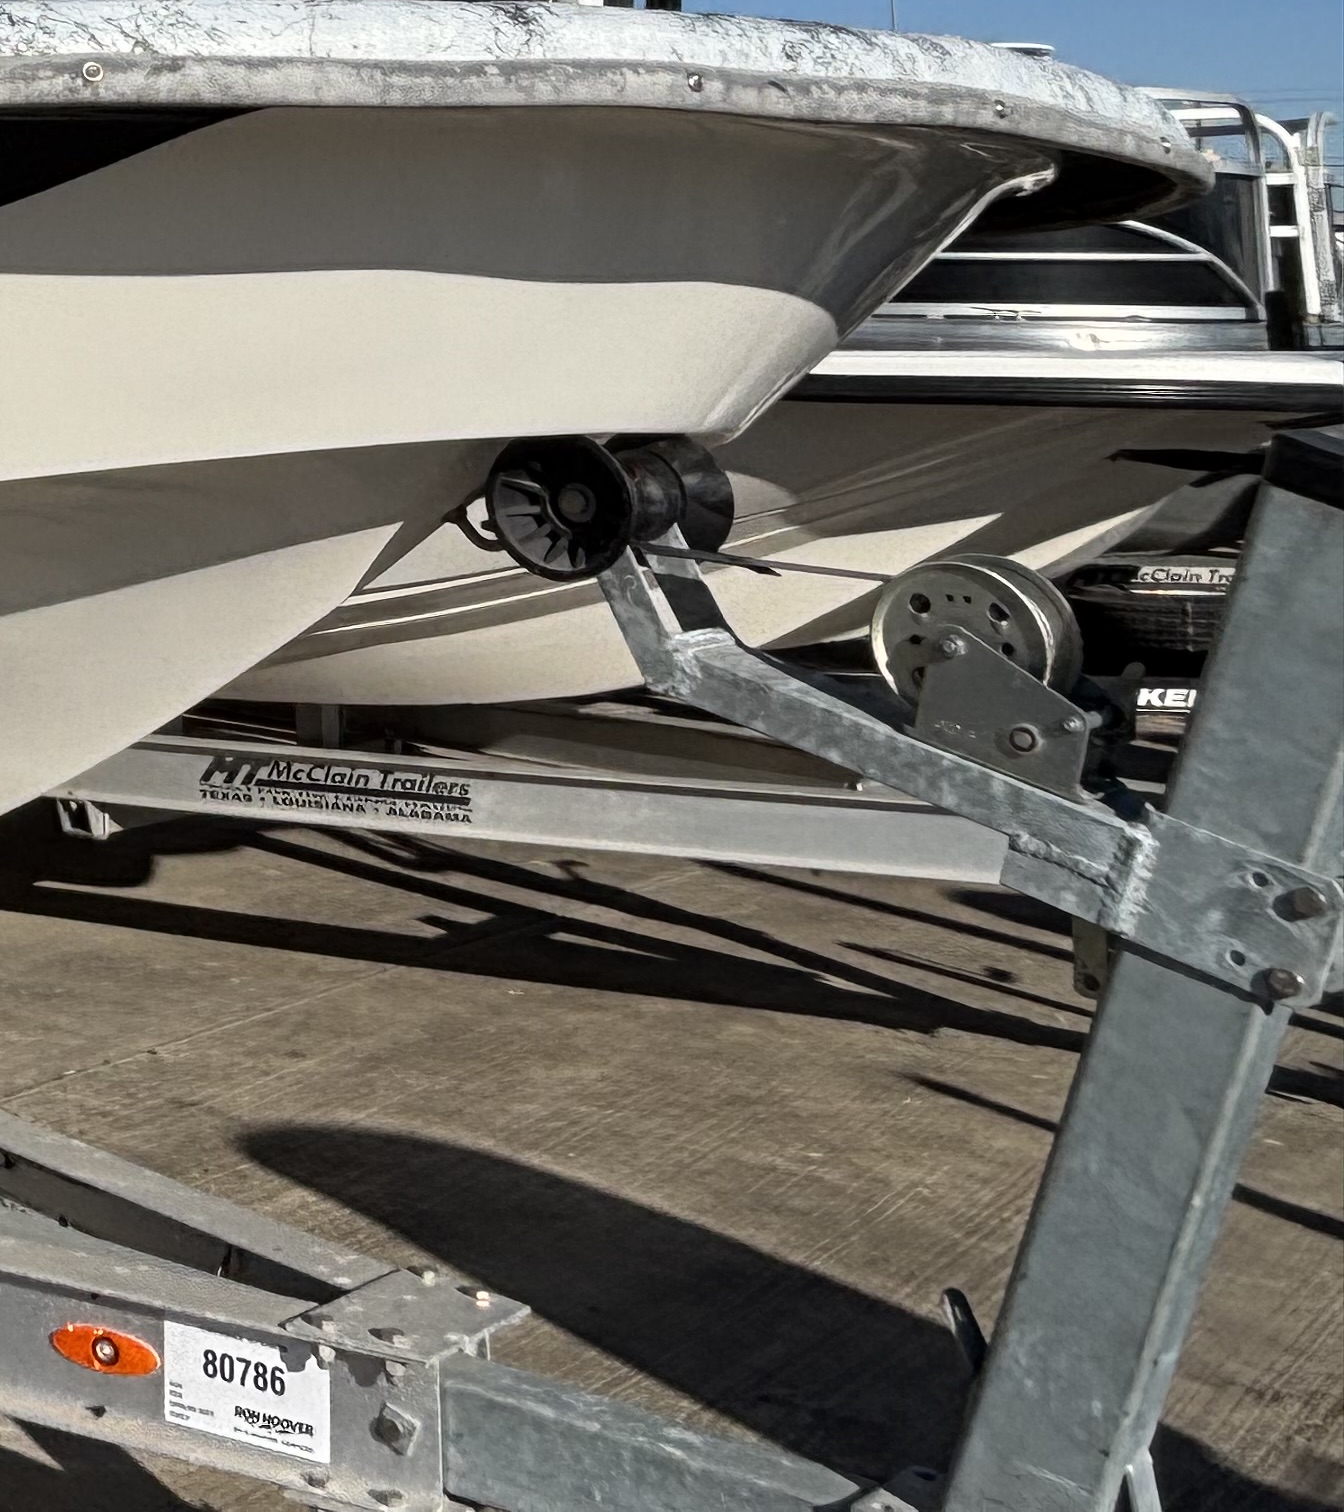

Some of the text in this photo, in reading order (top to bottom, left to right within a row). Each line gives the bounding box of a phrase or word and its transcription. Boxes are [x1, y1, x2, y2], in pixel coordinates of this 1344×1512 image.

[1139, 568, 1203, 583] cClain
[267, 759, 370, 787] McClain
[378, 769, 472, 796] Trailers
[202, 1348, 287, 1397] 80786
